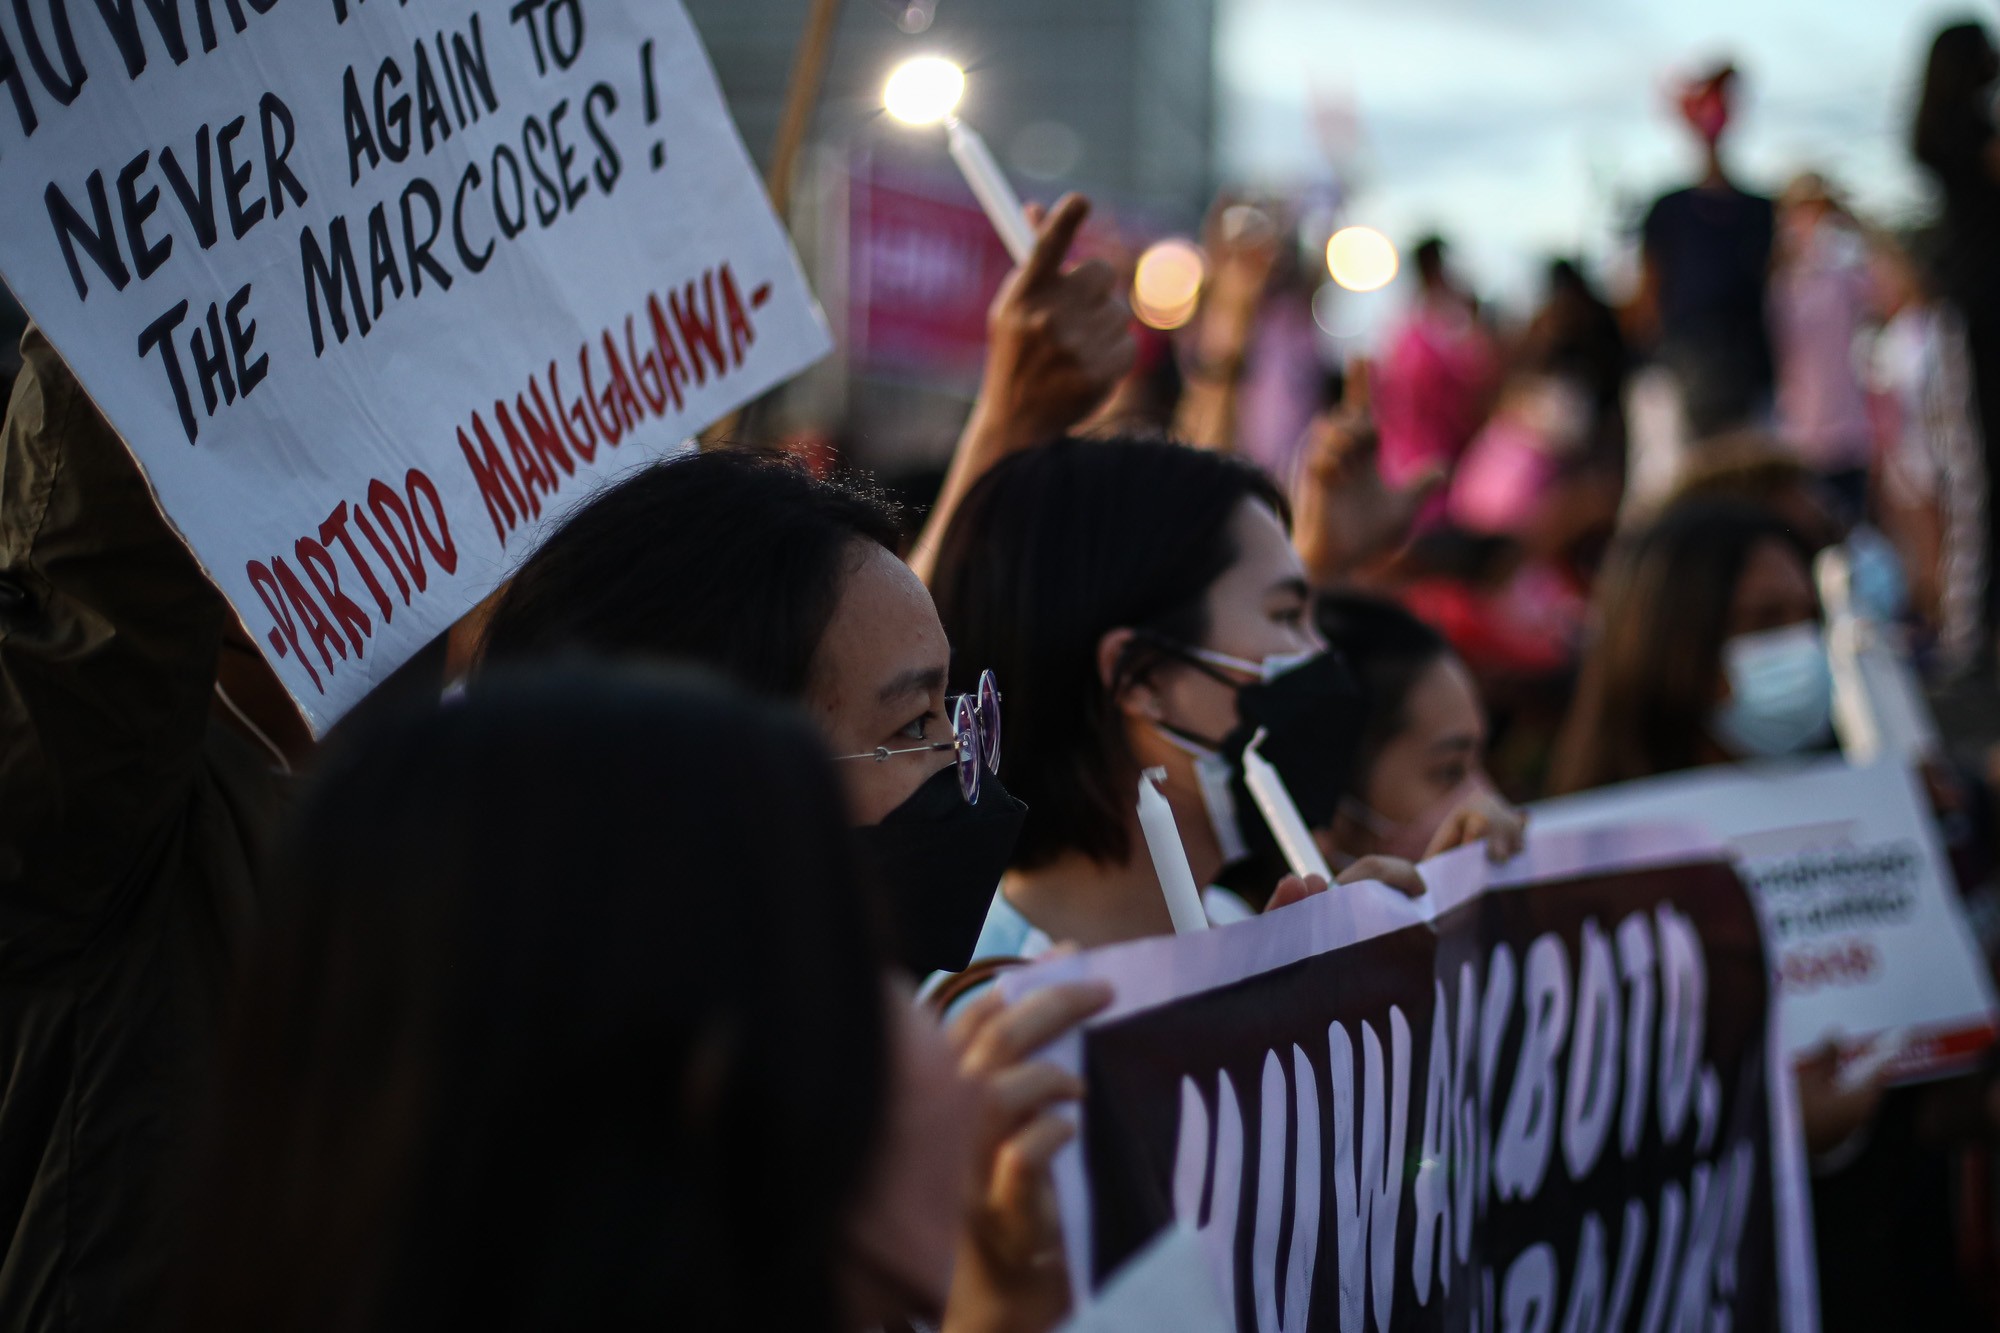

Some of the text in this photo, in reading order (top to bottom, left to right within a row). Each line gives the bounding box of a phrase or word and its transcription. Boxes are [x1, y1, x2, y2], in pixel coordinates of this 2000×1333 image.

[43, 91, 309, 303] NEVER
[342, 11, 499, 188] AGAIN
[509, 0, 585, 77] TO
[137, 283, 270, 447] THE
[299, 38, 667, 360] MARCOSES!
